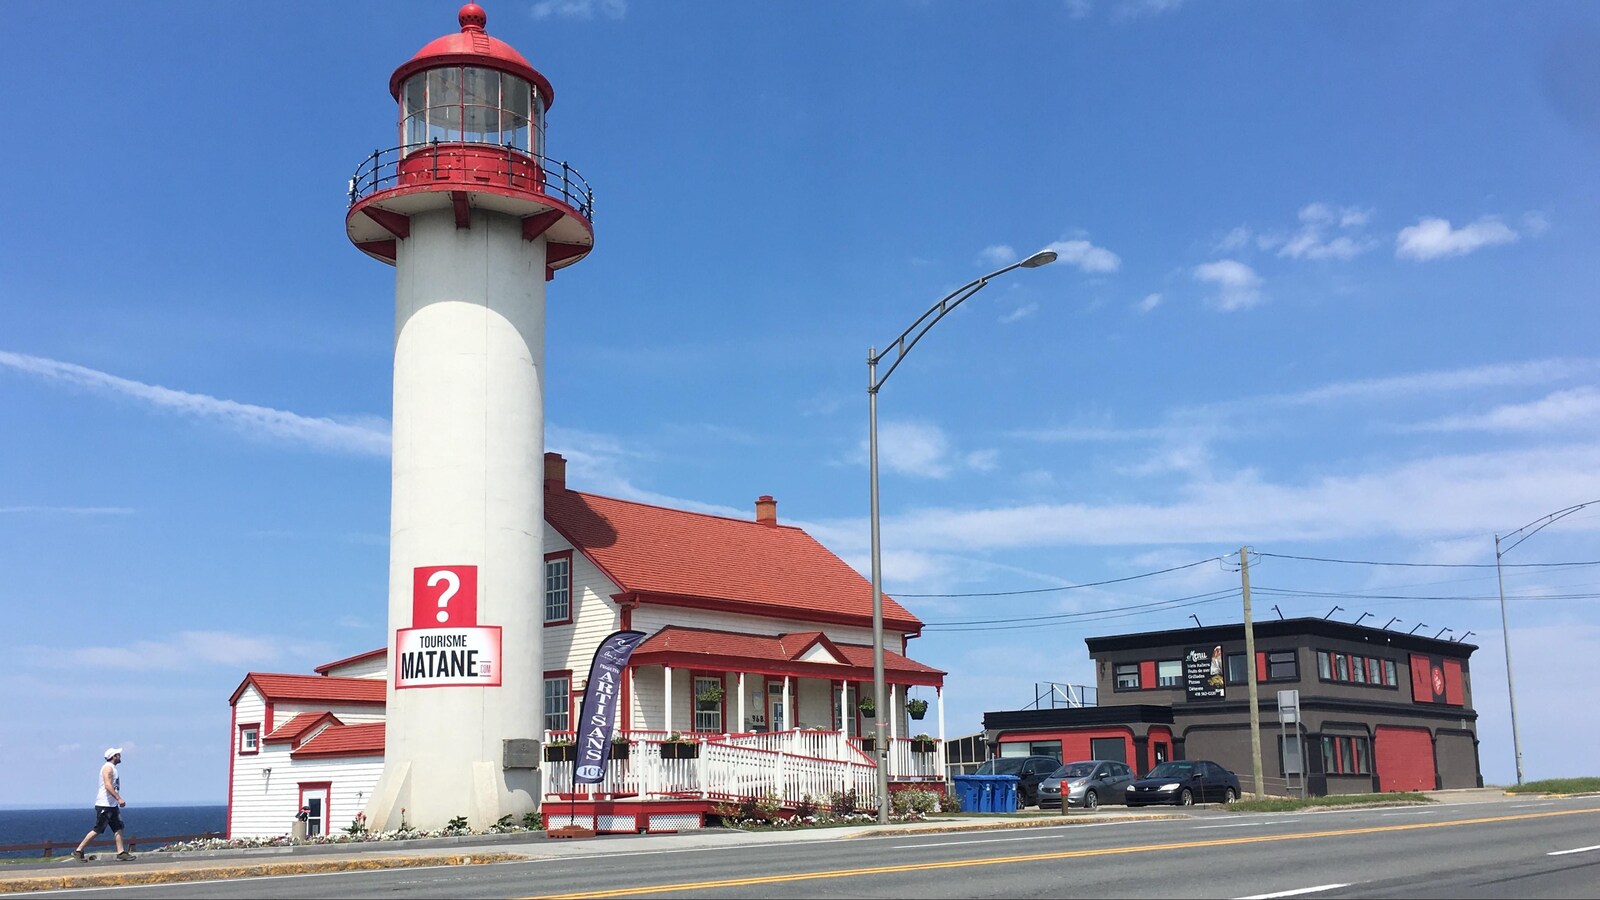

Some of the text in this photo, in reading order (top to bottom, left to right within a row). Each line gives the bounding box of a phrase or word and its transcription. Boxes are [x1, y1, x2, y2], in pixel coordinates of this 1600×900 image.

[420, 635, 467, 648] TOURISME
[401, 650, 478, 680] MATANE
[586, 672, 613, 760] ARTISANS
